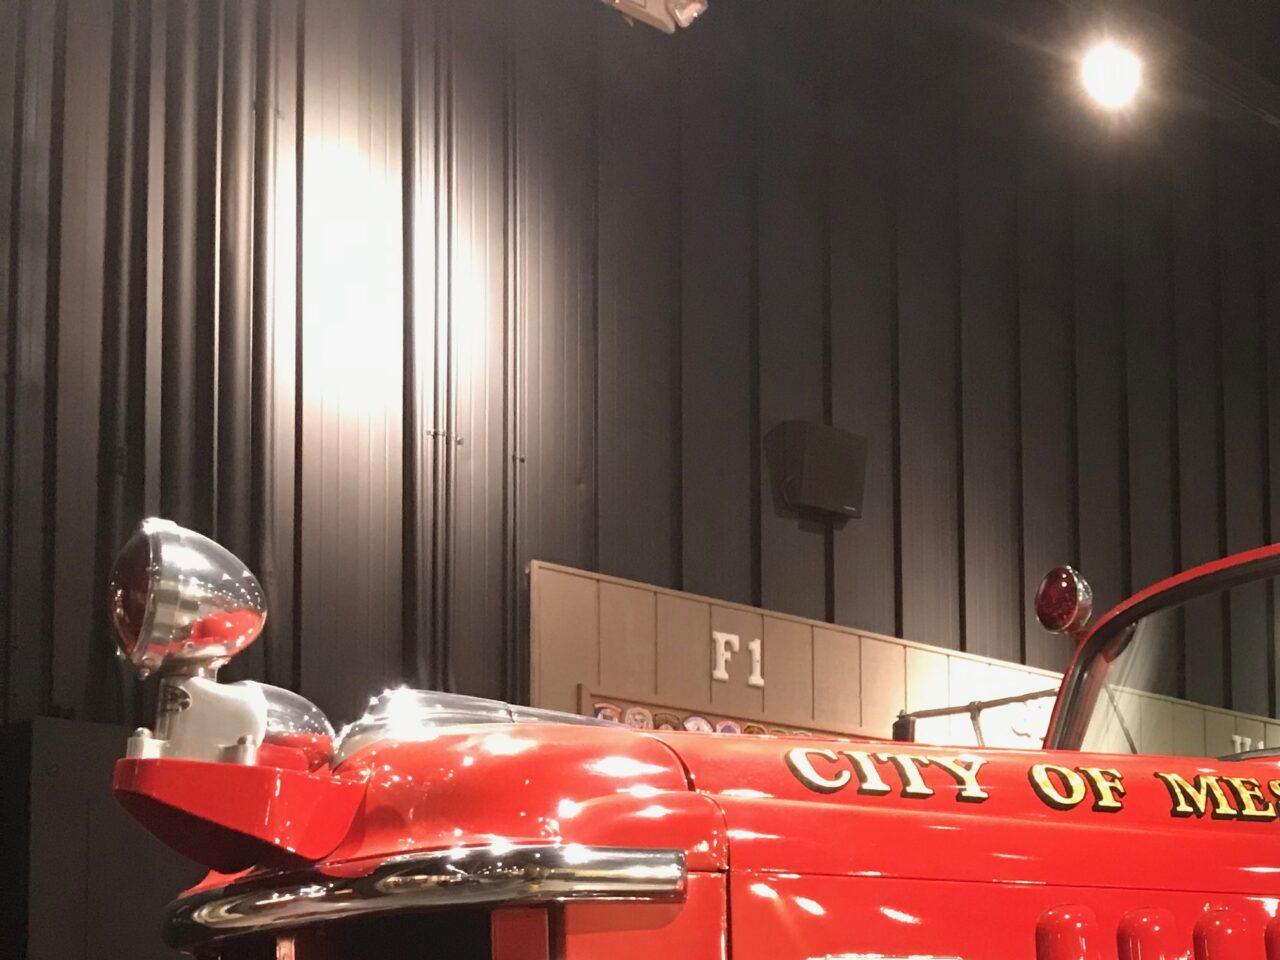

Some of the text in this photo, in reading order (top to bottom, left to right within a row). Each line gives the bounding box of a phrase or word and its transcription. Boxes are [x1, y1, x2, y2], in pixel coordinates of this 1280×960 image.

[712, 630, 765, 687] F1
[785, 747, 990, 803] CITY
[1028, 762, 1126, 812] OF
